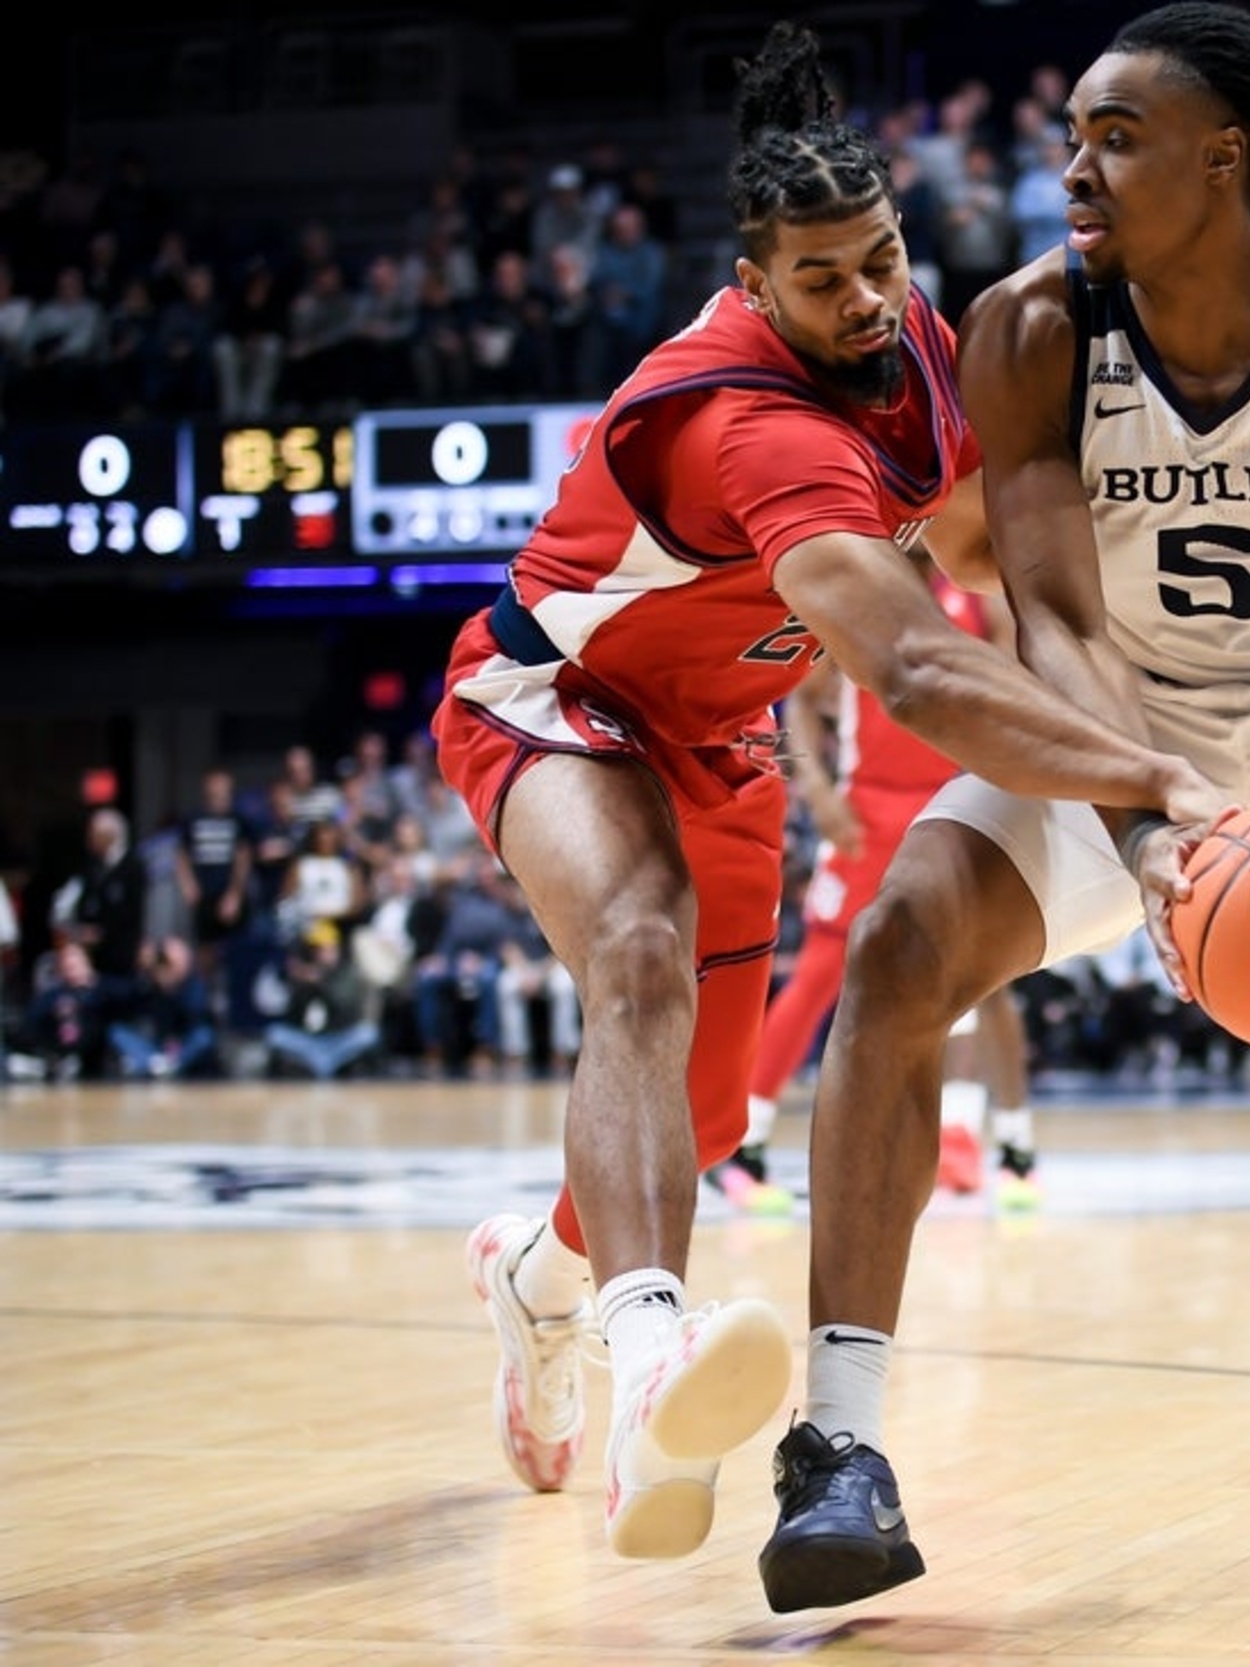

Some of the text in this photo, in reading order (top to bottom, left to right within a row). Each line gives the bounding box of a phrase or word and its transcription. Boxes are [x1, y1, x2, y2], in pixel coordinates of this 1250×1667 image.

[1091, 374, 1133, 387] CHANGE
[79, 434, 131, 497] 0
[432, 420, 489, 485] 0
[738, 613, 827, 666] 2
